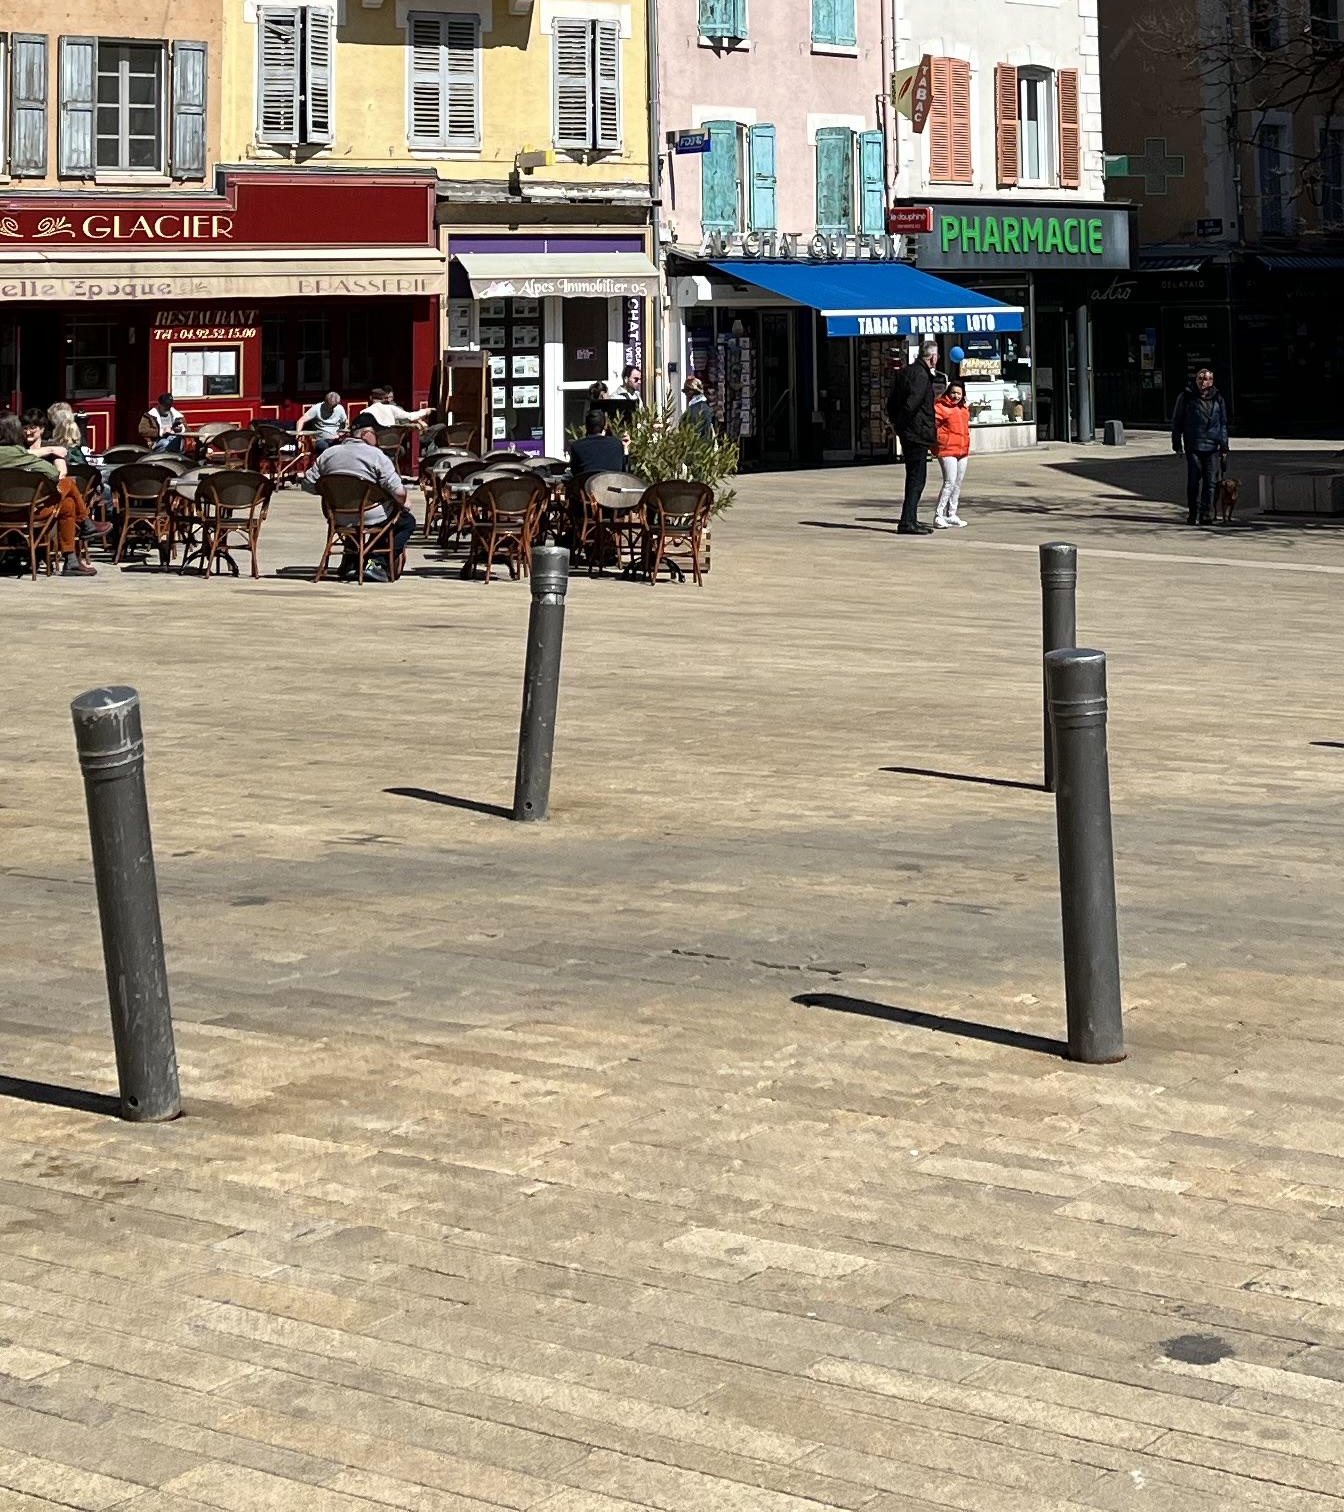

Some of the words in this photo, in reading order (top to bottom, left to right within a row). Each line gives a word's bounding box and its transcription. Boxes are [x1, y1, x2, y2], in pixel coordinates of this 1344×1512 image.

[914, 66, 928, 122] TABAC
[82, 214, 233, 239] GLACIER
[940, 215, 1104, 255] PHARMACIE
[298, 278, 433, 294] BRASSERIE
[518, 278, 554, 297] Alpes
[557, 278, 628, 294] Immobilier
[632, 283, 648, 297] 05
[154, 310, 258, 326] RESTAURANT
[858, 316, 898, 335] TABAC
[910, 315, 954, 334] PRESSE
[966, 314, 996, 332] LOTO
